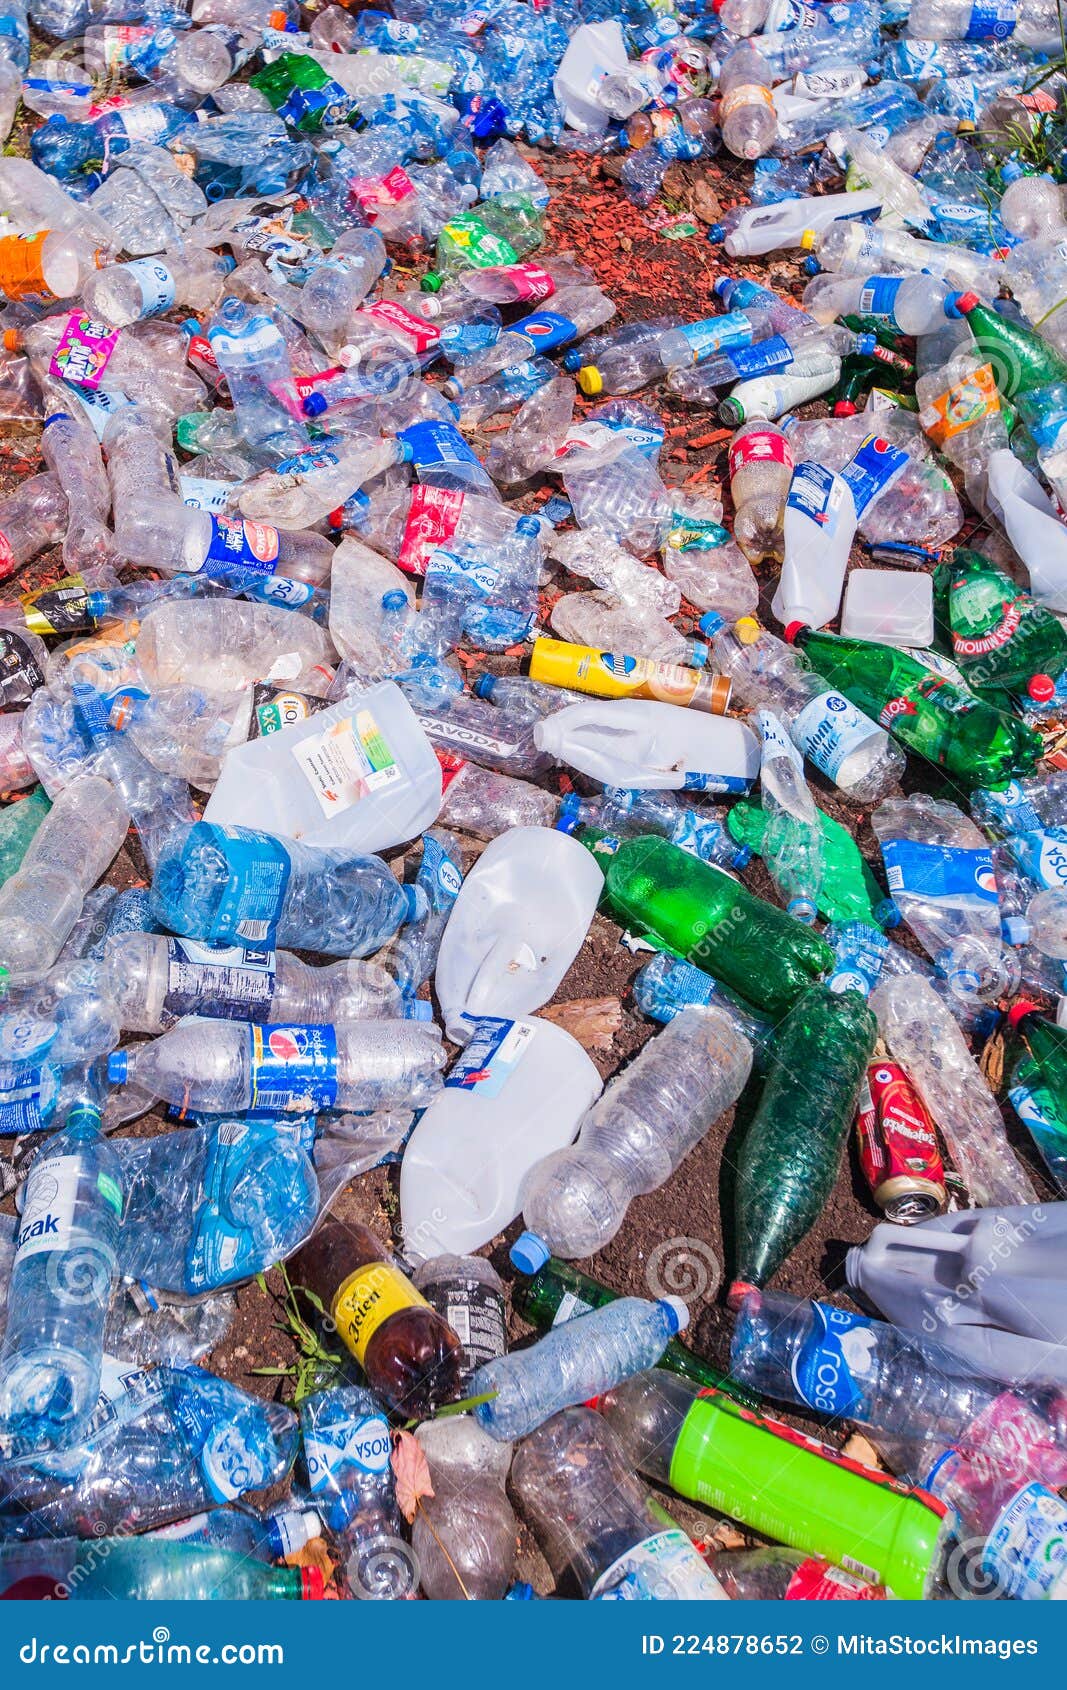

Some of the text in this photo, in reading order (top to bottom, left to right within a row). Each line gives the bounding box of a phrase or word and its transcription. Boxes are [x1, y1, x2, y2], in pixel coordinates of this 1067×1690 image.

[940, 206, 975, 217] ROSA
[626, 432, 654, 444] ROS
[271, 577, 294, 599] OSA
[474, 573, 496, 588] OSA
[953, 632, 998, 654] МИЛОШ
[17, 1214, 60, 1250] zak
[355, 1434, 390, 1452] ROSA
